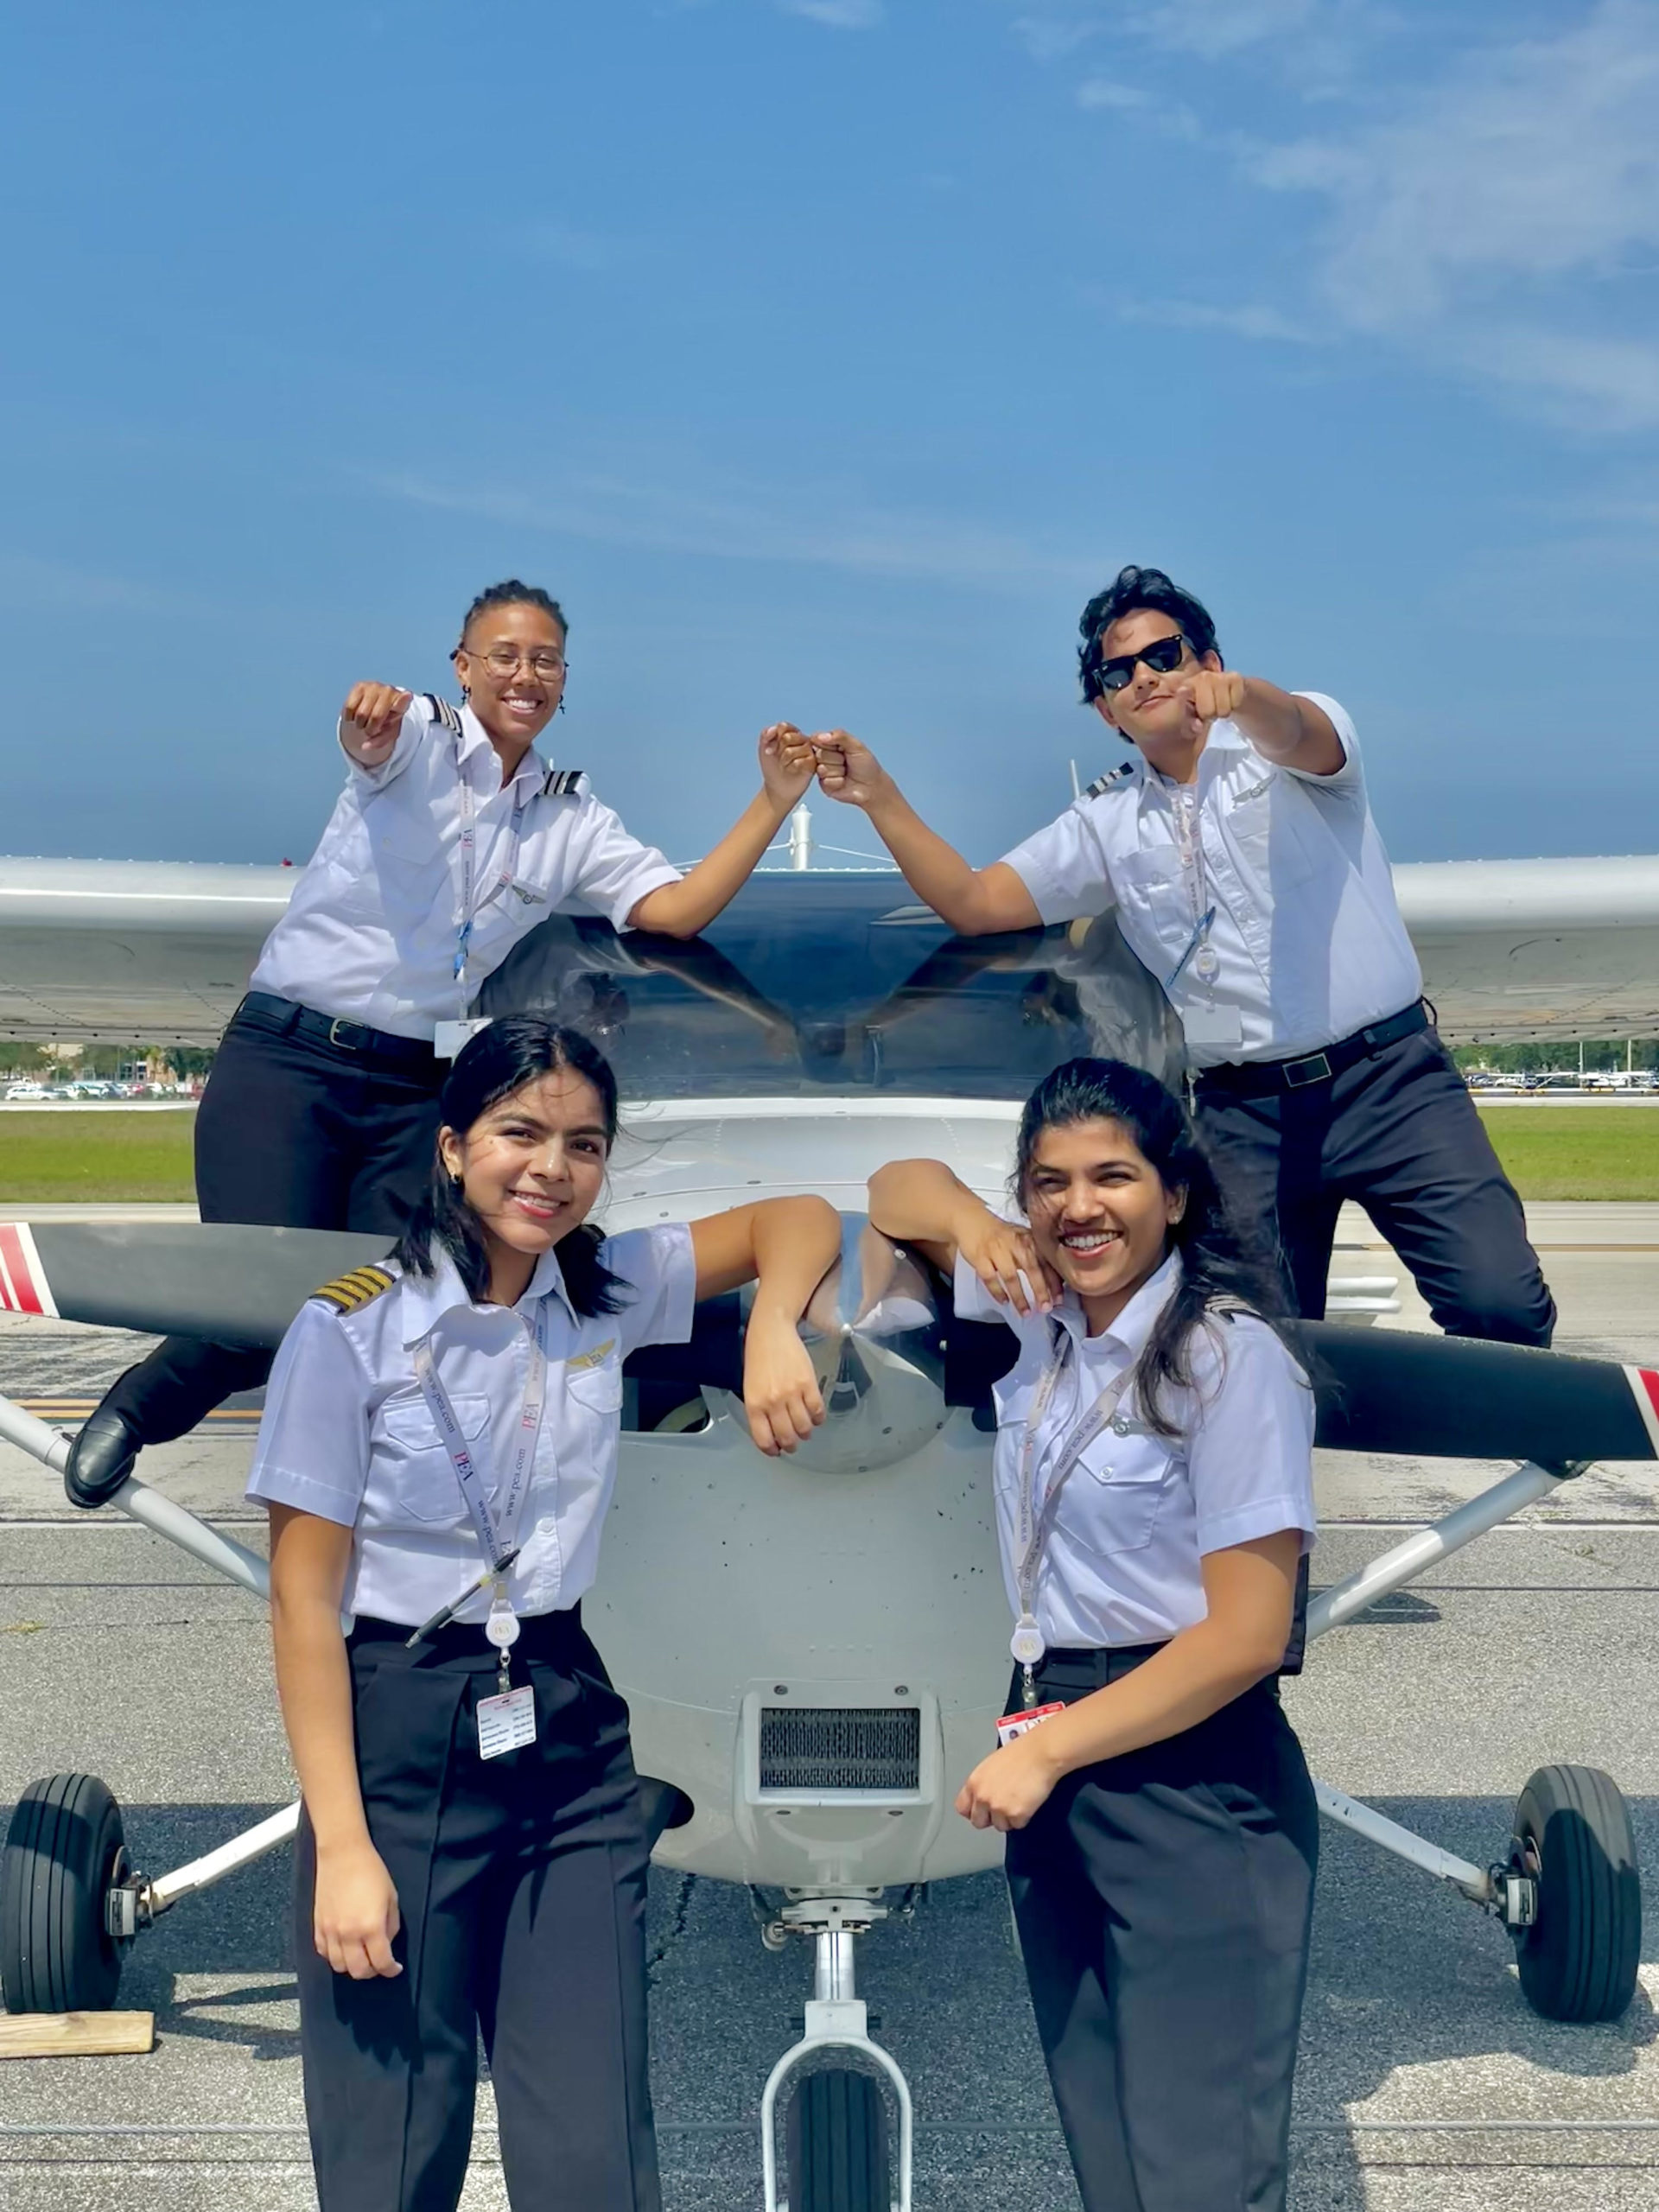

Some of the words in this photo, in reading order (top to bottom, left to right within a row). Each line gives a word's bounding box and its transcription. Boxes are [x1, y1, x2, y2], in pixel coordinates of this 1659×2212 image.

[425, 1368, 456, 1433] www.pea.com
[522, 1403, 540, 1430] PEA
[454, 1452, 474, 1482] PEA
[505, 1448, 525, 1517] www.pea.com
